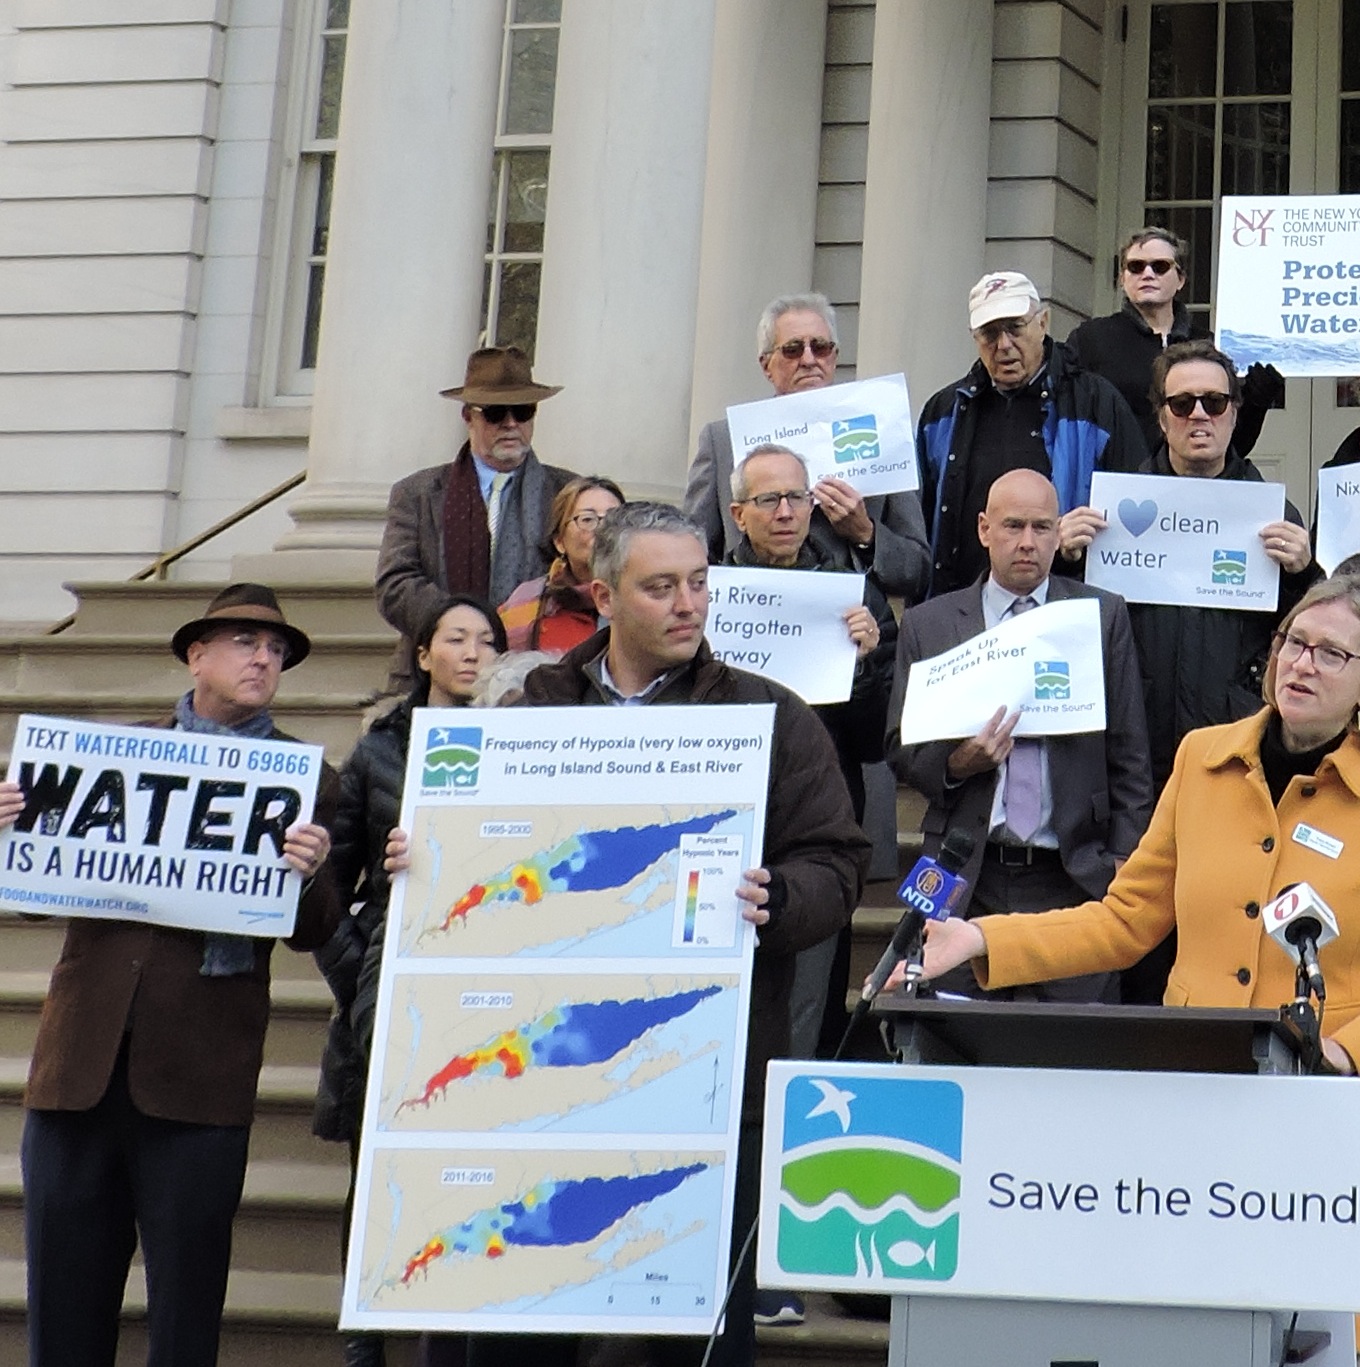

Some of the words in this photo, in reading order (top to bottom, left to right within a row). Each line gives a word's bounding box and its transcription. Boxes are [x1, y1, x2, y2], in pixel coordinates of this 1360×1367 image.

[1284, 209, 1310, 220] THE
[1314, 208, 1345, 219] NEW
[1283, 235, 1325, 247] TRUST
[774, 423, 809, 439] Island
[847, 466, 867, 477] the
[1336, 483, 1360, 497] Nix
[1160, 511, 1220, 535] clean
[1100, 549, 1168, 569] water
[728, 586, 782, 606] River:
[714, 613, 802, 639] forgotten
[929, 648, 972, 675] Speak
[978, 637, 999, 650] Up
[926, 674, 947, 687] for
[951, 656, 981, 676] East
[986, 647, 1027, 662] River
[1043, 703, 1060, 713] the
[25, 726, 70, 751] TEXT
[75, 732, 210, 766] WATERFORALL
[217, 747, 241, 768] TO
[247, 750, 311, 775] 69866
[485, 738, 558, 752] Frequency
[562, 737, 577, 749] of
[579, 737, 636, 752] Hypoxia
[639, 736, 675, 751] (very
[678, 736, 704, 748] low
[706, 735, 763, 750] oxygen)
[504, 762, 517, 775] in
[521, 762, 557, 777] Long
[561, 761, 602, 774] Island
[606, 761, 651, 774] Sound
[655, 761, 666, 773] &
[670, 761, 701, 773] East
[705, 760, 743, 773] River
[13, 761, 302, 859] WATER
[6, 841, 35, 872] IS
[44, 846, 62, 876] A
[74, 849, 186, 888] HUMAN
[196, 858, 292, 898] RIGHT
[902, 885, 935, 913] NTD
[461, 994, 512, 1006] 2001-2010
[443, 1171, 494, 1183] 2011-2016
[988, 1173, 1099, 1212] Save
[1115, 1178, 1192, 1216] the
